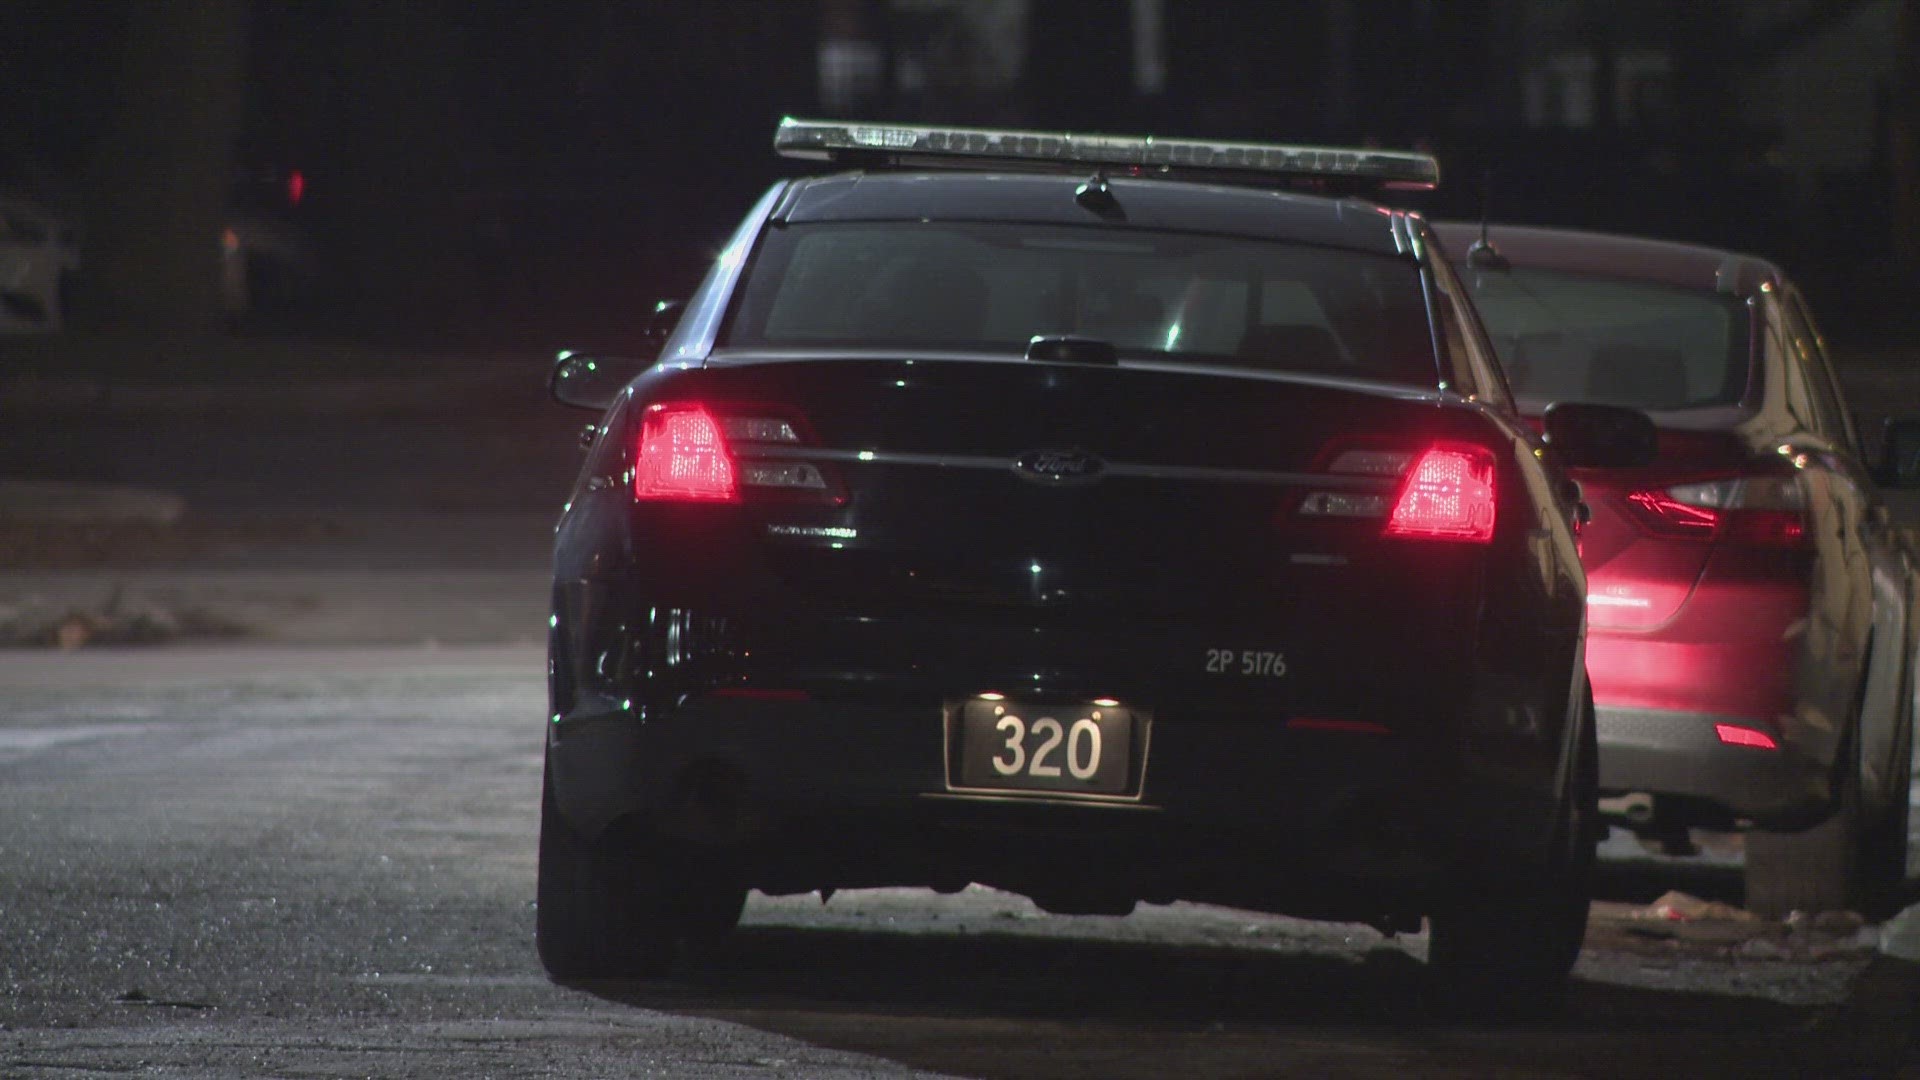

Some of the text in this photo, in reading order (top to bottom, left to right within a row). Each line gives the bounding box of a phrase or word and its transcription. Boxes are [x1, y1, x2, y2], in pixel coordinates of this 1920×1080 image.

[1032, 454, 1088, 474] Ford
[1206, 648, 1286, 677] 2P 5176
[992, 715, 1102, 780] 320
